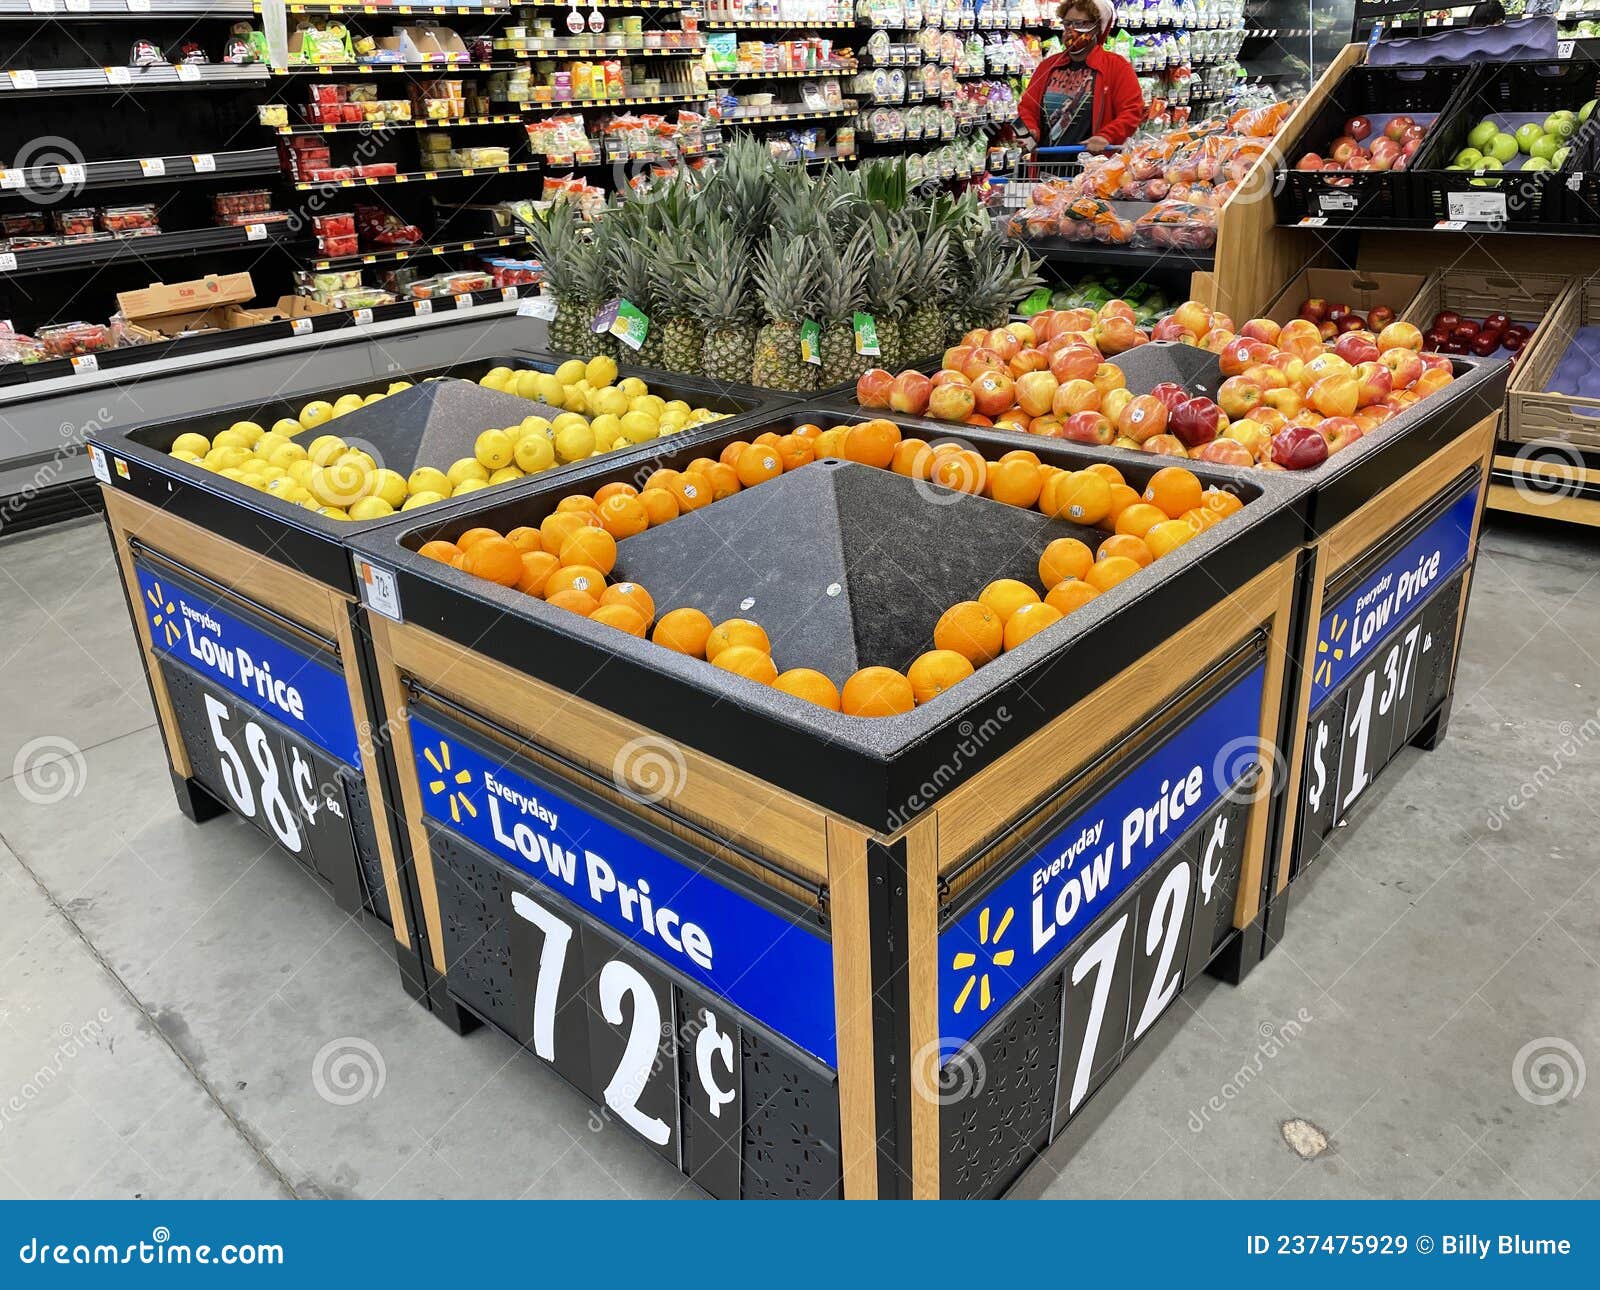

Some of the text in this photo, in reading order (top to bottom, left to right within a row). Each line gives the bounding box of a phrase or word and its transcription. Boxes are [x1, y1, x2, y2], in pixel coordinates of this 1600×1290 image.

[179, 600, 221, 637] Everyday
[1349, 550, 1441, 658] Low Price
[1355, 572, 1392, 614] Everyday
[184, 617, 304, 720] Low Price
[484, 771, 558, 831] Everyday
[488, 794, 713, 970] Low Price
[1032, 819, 1104, 894] Everyday
[1032, 765, 1203, 955] Low Price
